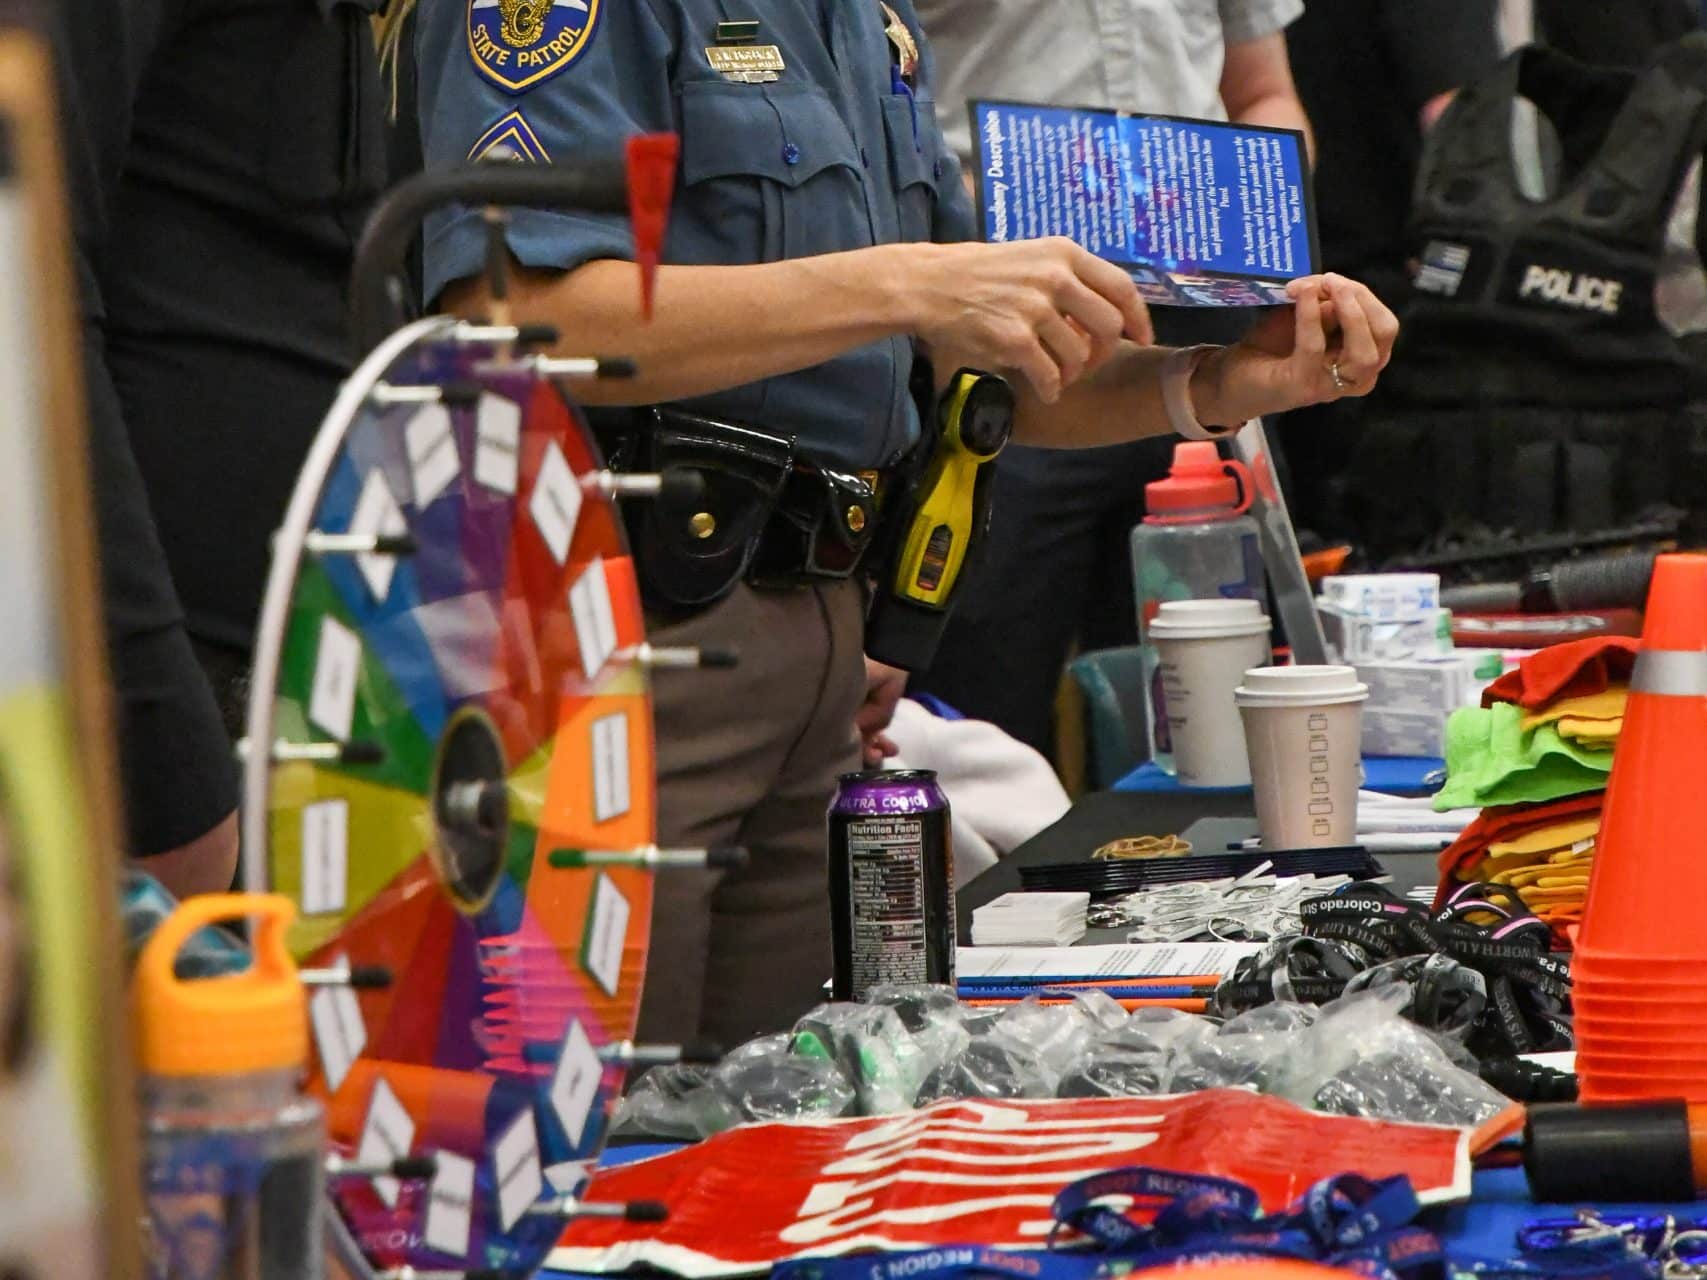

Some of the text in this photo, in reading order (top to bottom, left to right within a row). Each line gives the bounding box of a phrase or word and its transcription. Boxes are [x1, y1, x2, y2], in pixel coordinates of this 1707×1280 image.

[473, 23, 581, 68] STATE PATROL
[1519, 265, 1623, 315] POLICE
[1319, 899, 1383, 914] Colorado
[889, 1248, 974, 1278] REGION
